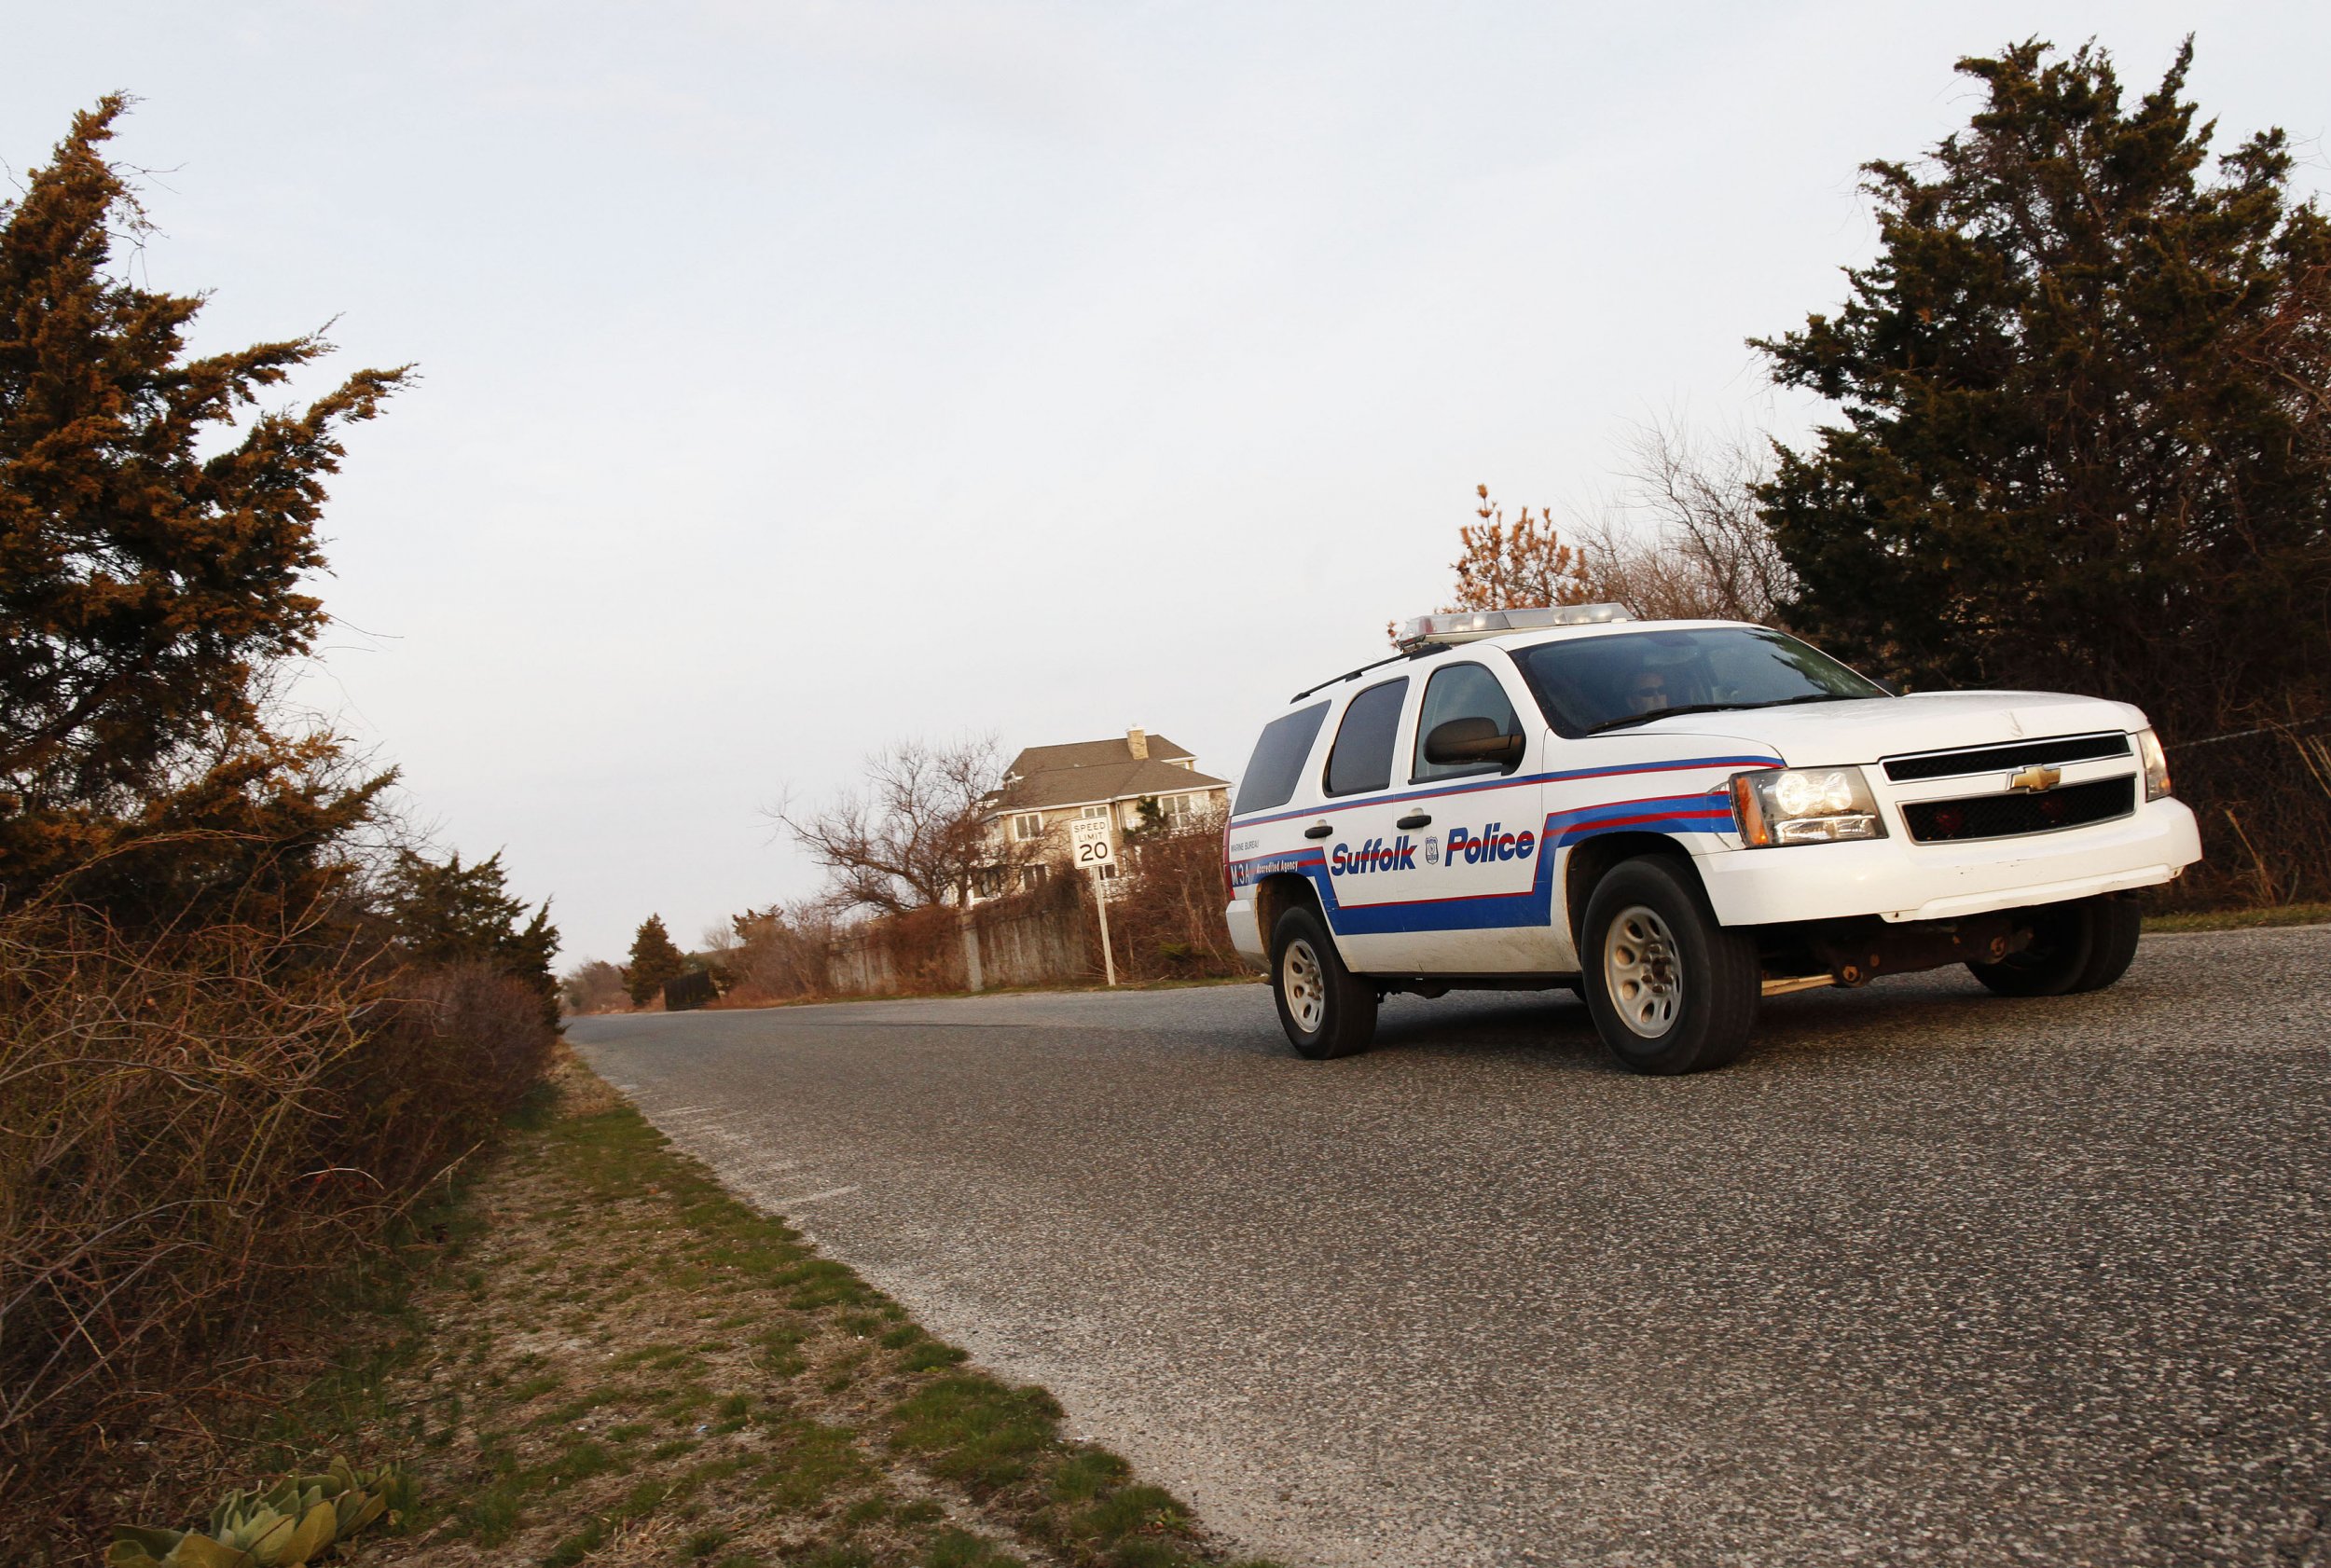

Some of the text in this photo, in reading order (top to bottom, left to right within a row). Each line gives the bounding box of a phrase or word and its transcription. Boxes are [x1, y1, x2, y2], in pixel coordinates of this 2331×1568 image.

[1073, 822, 1106, 832] SPEED
[1079, 832, 1103, 842] LIMIT
[1080, 842, 1108, 861] 20
[1231, 840, 1260, 852] MARINE BUREAU
[1331, 821, 1536, 876] Suffolk Police
[1256, 860, 1299, 874] Accredited Agency
